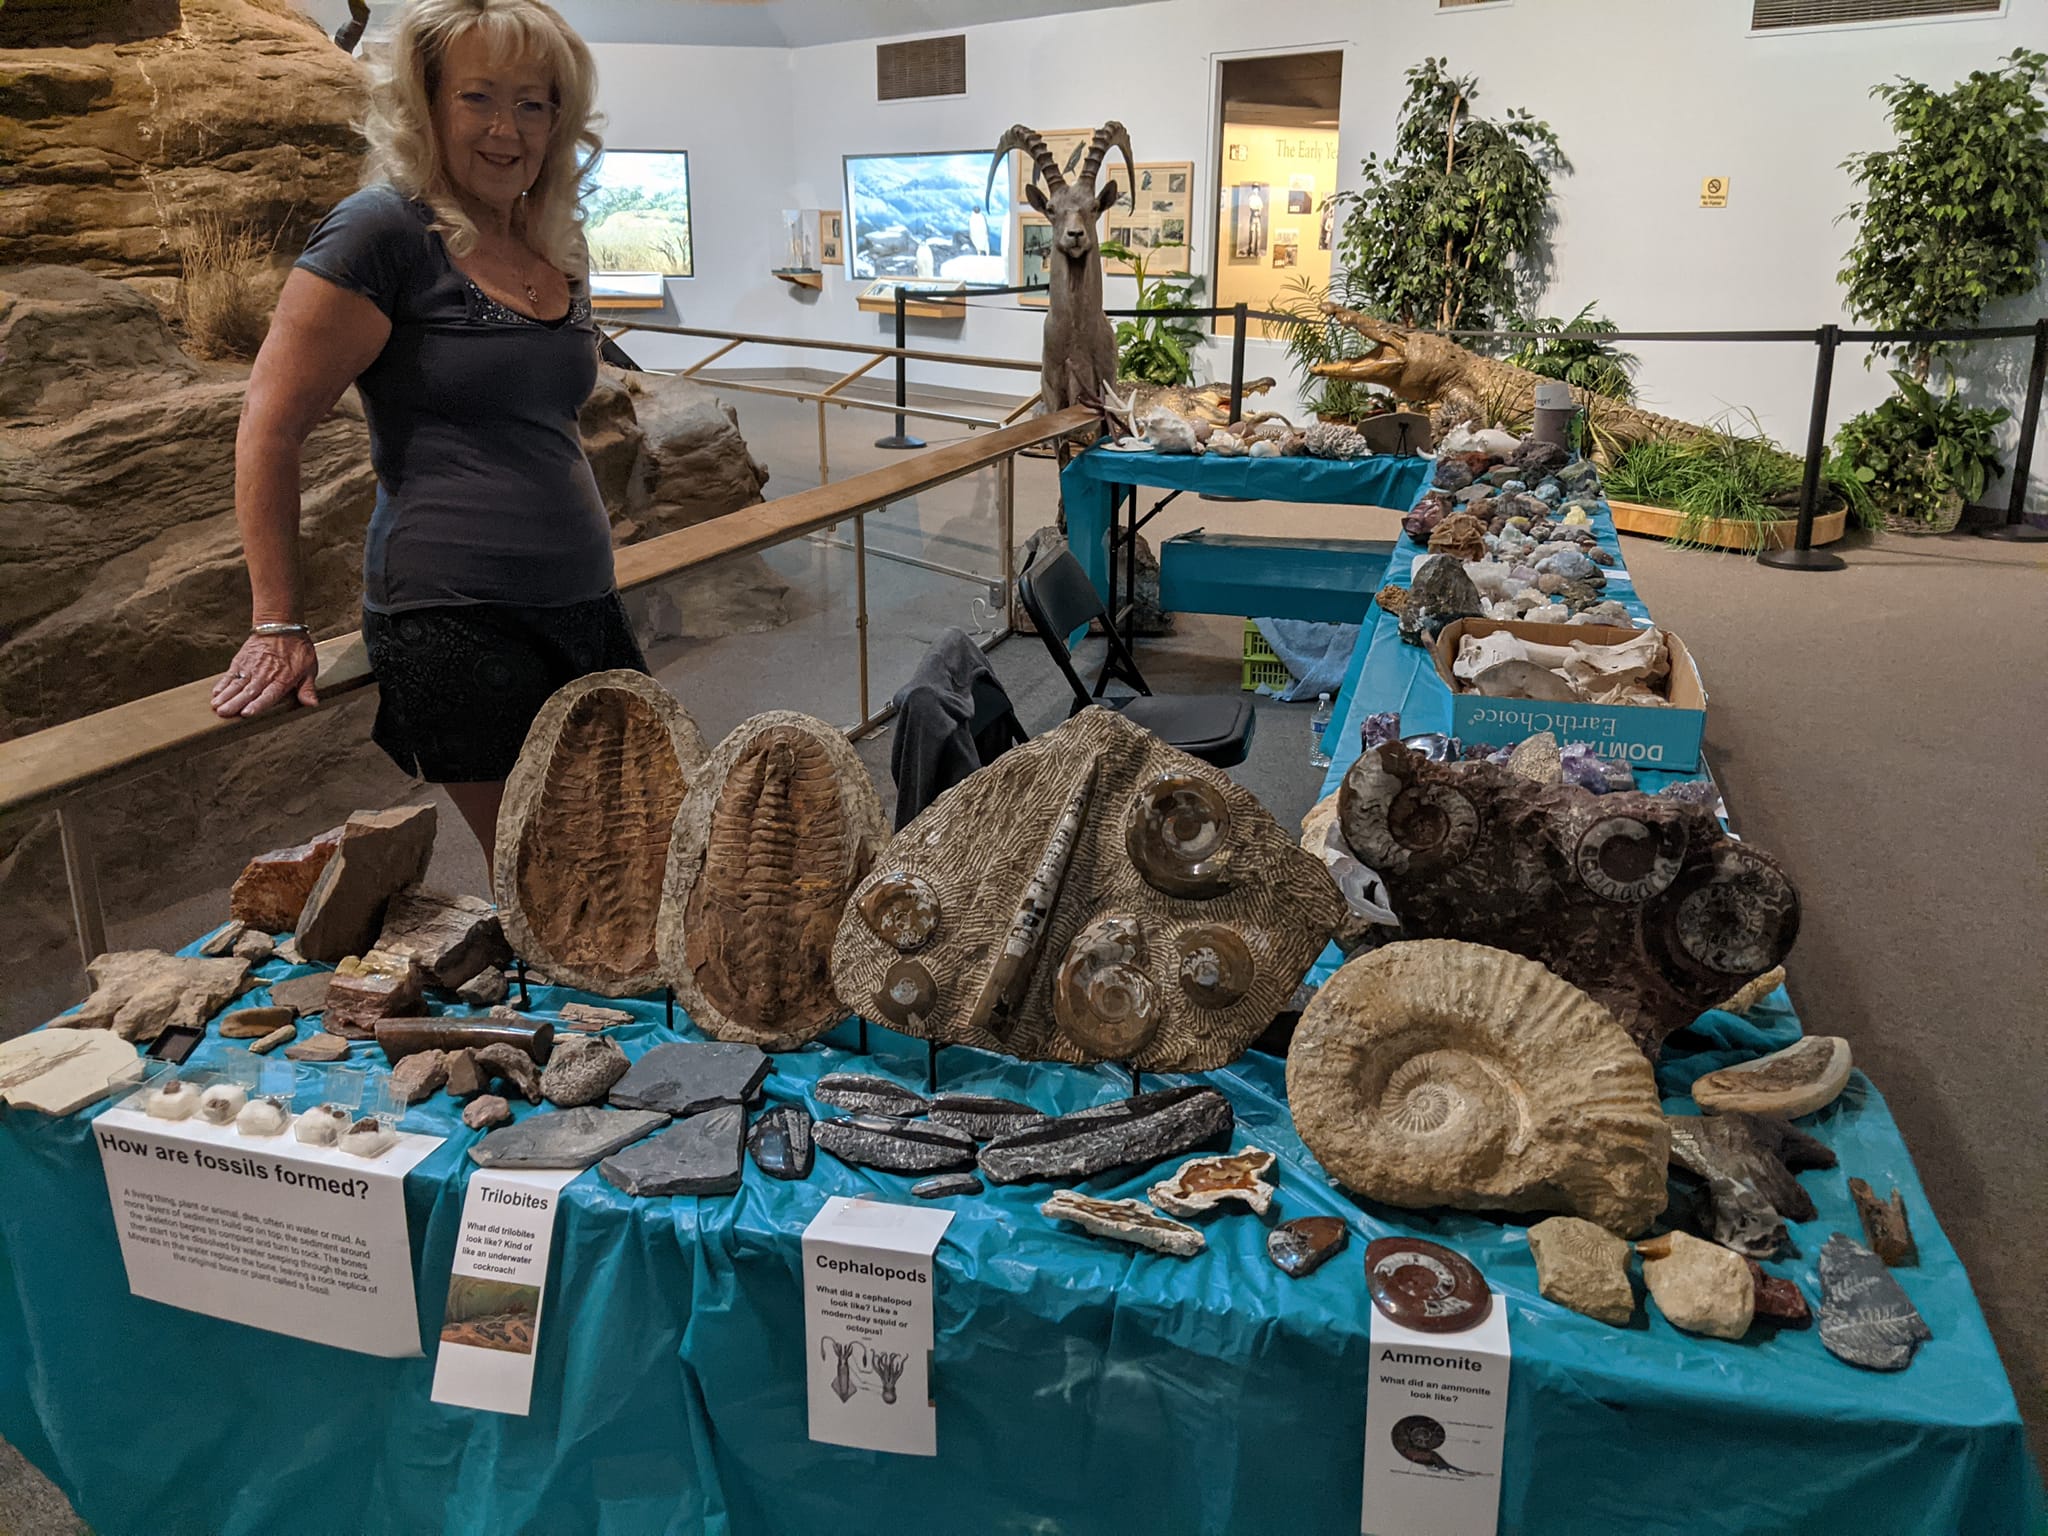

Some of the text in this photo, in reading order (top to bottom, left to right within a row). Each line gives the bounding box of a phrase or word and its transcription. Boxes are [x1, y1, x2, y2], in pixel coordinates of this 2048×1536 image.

[1276, 139, 1339, 163] The Early Ye
[100, 1132, 369, 1199] How are fossils formed?
[481, 1186, 548, 1210] Trilobites
[124, 1188, 130, 1196] A
[131, 1190, 153, 1202] living
[179, 1200, 199, 1210] plant
[201, 1204, 209, 1212] or
[263, 1217, 284, 1229] often
[286, 1223, 294, 1231] in
[296, 1226, 318, 1236] water
[320, 1231, 330, 1239] or
[332, 1233, 353, 1244] mud.
[355, 1237, 367, 1247] As
[124, 1200, 145, 1210] more
[146, 1203, 170, 1214] layers
[172, 1208, 180, 1216] of
[182, 1212, 220, 1225] sediment
[221, 1220, 242, 1230] build
[243, 1226, 254, 1234] up
[255, 1227, 266, 1236] on
[285, 1233, 298, 1243] the
[300, 1238, 338, 1252] sediment
[340, 1246, 370, 1260] around
[130, 1210, 142, 1220] the
[144, 1215, 178, 1227] skeleton
[180, 1221, 207, 1234] begins
[208, 1227, 217, 1236] to
[218, 1230, 254, 1244] compact
[256, 1239, 272, 1248] and
[272, 1241, 290, 1253] turn
[291, 1246, 300, 1256] to
[324, 1252, 339, 1264] The
[341, 1256, 368, 1270] bones
[467, 1221, 536, 1240] What did trilobites
[129, 1222, 148, 1232] then
[149, 1226, 168, 1236] start
[169, 1230, 178, 1238] to
[180, 1232, 190, 1240] be
[192, 1235, 230, 1250] dissolved
[231, 1243, 240, 1254] by
[242, 1248, 265, 1258] water
[267, 1252, 300, 1267] seeping
[300, 1260, 333, 1274] through
[334, 1268, 348, 1278] the
[466, 1234, 532, 1252] look like? Kind of
[128, 1232, 161, 1246] Minerals
[162, 1240, 170, 1248] in
[172, 1241, 185, 1251] the
[186, 1245, 208, 1256] water
[210, 1250, 240, 1264] replace
[241, 1256, 254, 1267] the
[280, 1265, 309, 1282] leaving
[310, 1274, 316, 1282] a
[318, 1275, 336, 1286] rock
[338, 1279, 367, 1292] replica
[368, 1286, 378, 1294] of
[462, 1246, 533, 1265] like an underwater
[172, 1251, 186, 1262] the
[188, 1256, 218, 1269] original
[218, 1262, 239, 1273] bone
[240, 1268, 249, 1276] or
[250, 1270, 272, 1282] plant
[272, 1276, 298, 1288] called
[298, 1282, 304, 1290] a
[472, 1262, 516, 1276] cockroach!
[816, 1255, 928, 1284] Cephalopods
[816, 1284, 838, 1296] What
[840, 1288, 854, 1298] did
[862, 1293, 912, 1307] cephalopod
[830, 1298, 848, 1308] look
[850, 1302, 870, 1312] like?
[872, 1305, 890, 1315] Like
[821, 1308, 871, 1324] modern-day
[872, 1316, 897, 1328] squid
[846, 1324, 883, 1336] octopus!
[1380, 1349, 1482, 1372] Ammonite
[1380, 1375, 1406, 1386] What
[1408, 1379, 1424, 1388] did
[1440, 1383, 1491, 1396] ammonite
[1410, 1390, 1458, 1403] look like?
